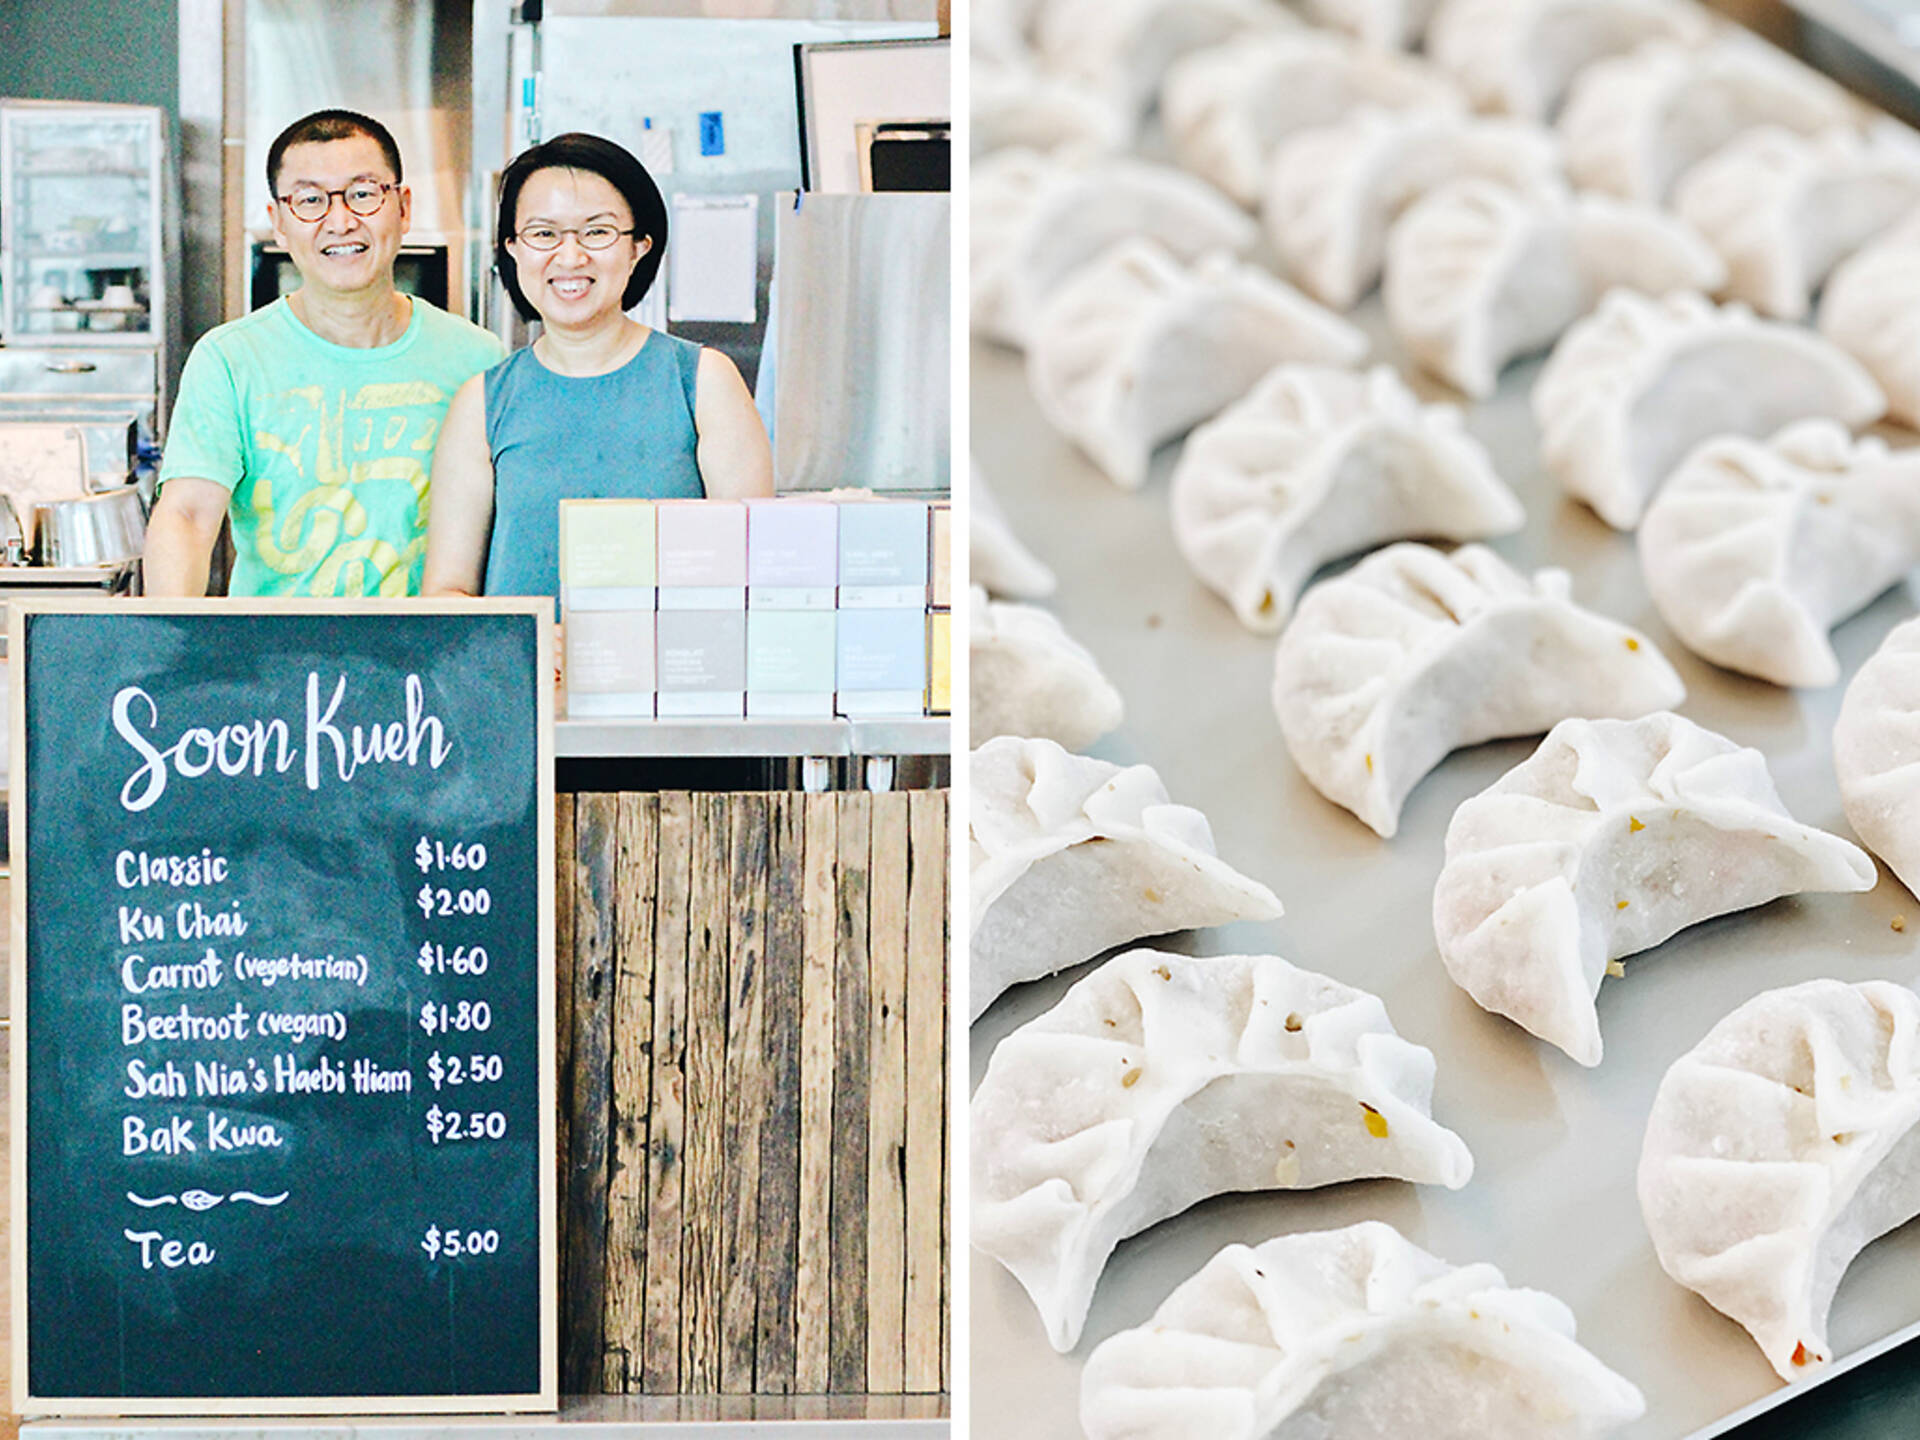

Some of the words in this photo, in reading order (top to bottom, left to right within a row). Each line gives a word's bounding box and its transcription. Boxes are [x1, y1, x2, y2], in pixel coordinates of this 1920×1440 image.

[111, 686, 298, 812] Soon
[304, 671, 453, 791] Kueh
[115, 847, 229, 889] Classic
[415, 836, 487, 874] $1.60
[118, 906, 164, 945] Ku
[176, 900, 249, 940] Chai
[416, 883, 491, 919] $2.00
[121, 947, 223, 994] Carrot
[234, 951, 369, 987] (vegetarian)
[417, 941, 488, 975] $1.60
[121, 1002, 250, 1046] Beetroot
[256, 1011, 347, 1044] (vegan)
[419, 1000, 491, 1037] $1.80
[124, 1059, 187, 1099] Sah
[194, 1057, 269, 1097] Nia's
[273, 1053, 346, 1094] Haebi
[428, 1050, 503, 1091] $2.50
[207, 1111, 283, 1151] Kwa
[426, 1104, 506, 1144] $2.50
[124, 1228, 215, 1269] Tea
[421, 1224, 499, 1260] $5.00
